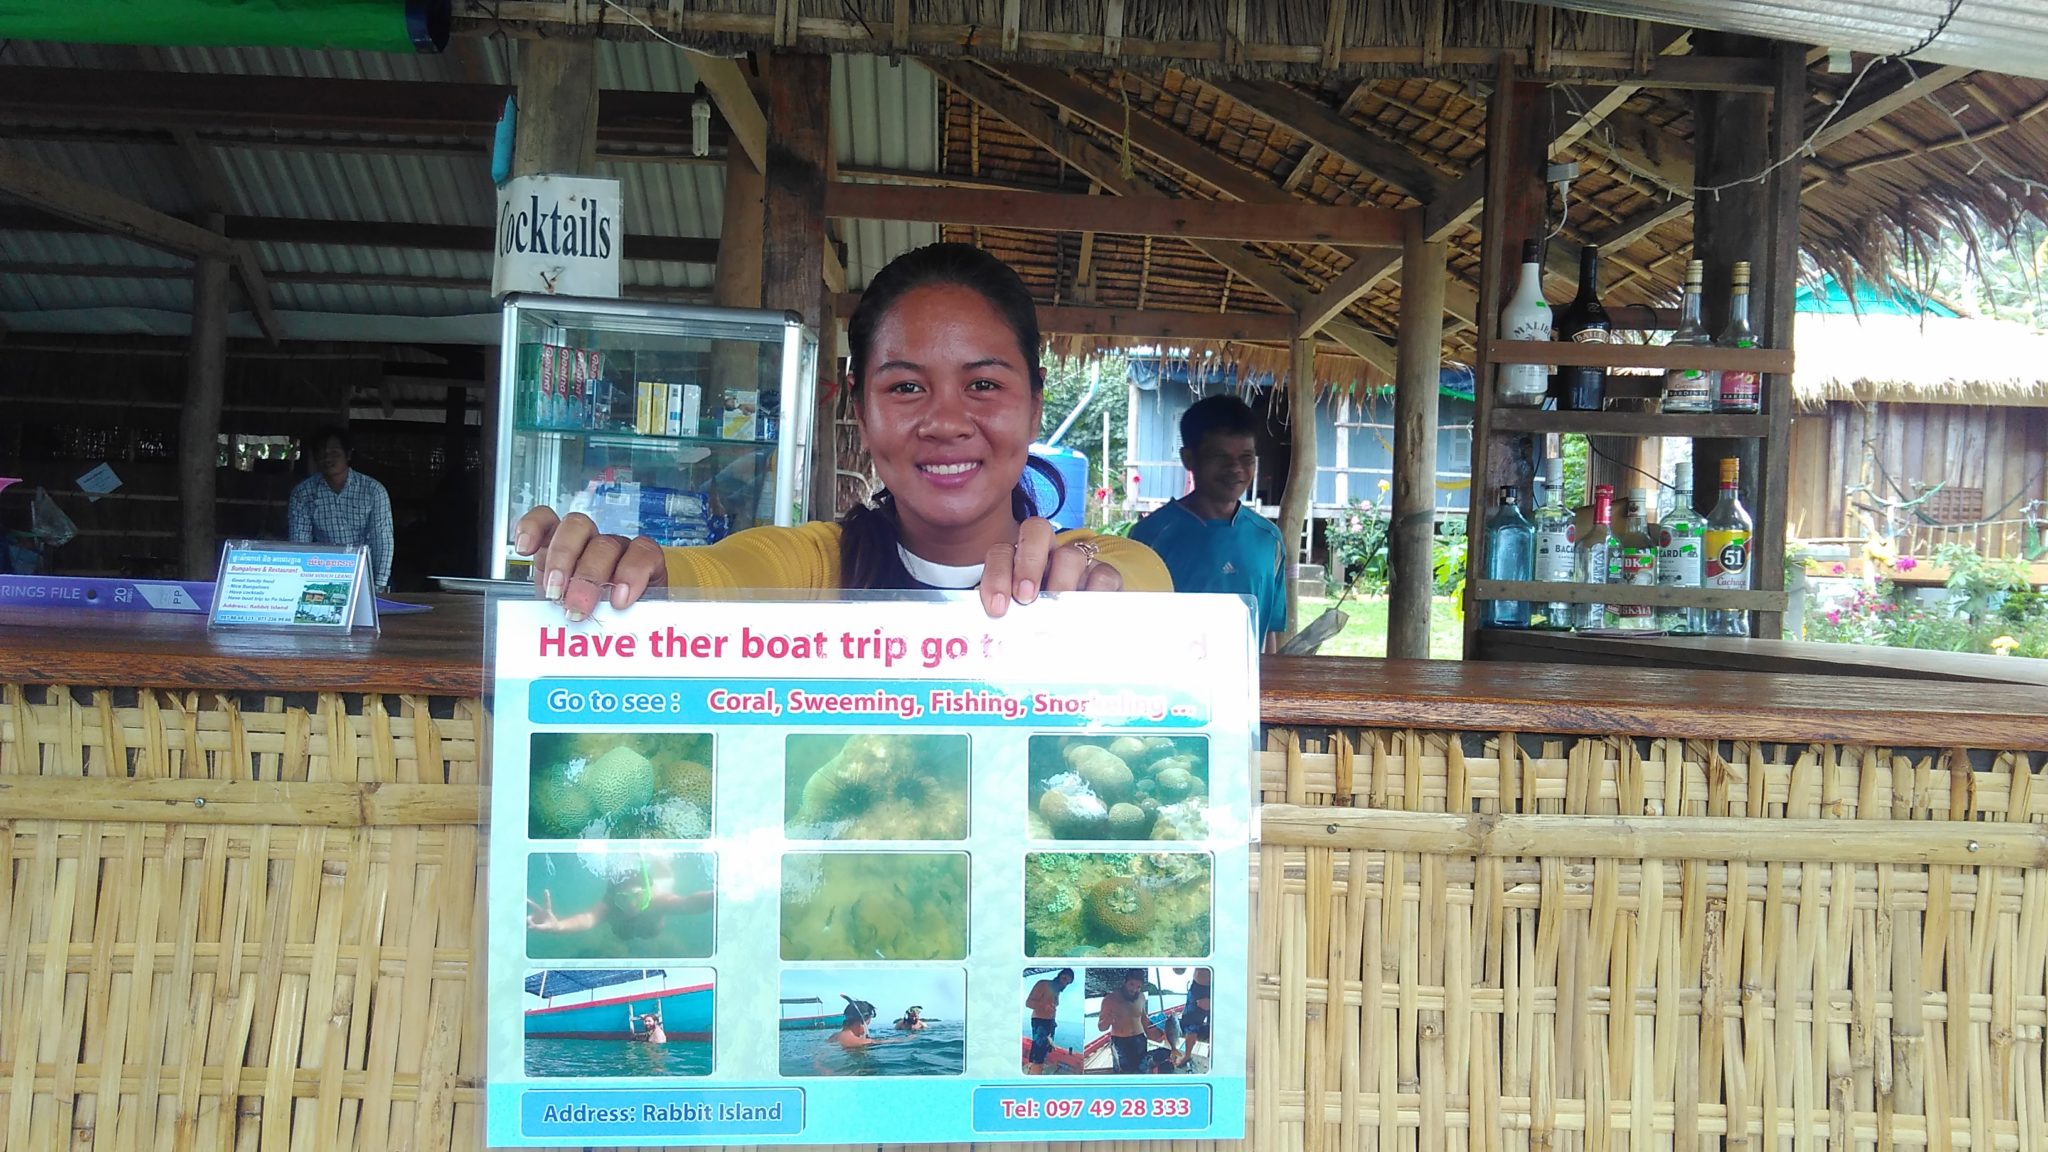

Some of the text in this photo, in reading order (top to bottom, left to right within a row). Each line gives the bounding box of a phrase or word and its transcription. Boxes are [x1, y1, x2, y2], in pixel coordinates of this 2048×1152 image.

[499, 195, 612, 259] Cocktails
[1724, 549, 1743, 566] 51
[50, 587, 81, 600] FILE
[114, 587, 128, 602] 20
[173, 590, 182, 605] PP
[539, 627, 636, 657] Have
[649, 627, 728, 658] ther
[742, 627, 828, 659] boat
[840, 628, 908, 667] trip
[921, 636, 968, 668] go
[549, 689, 583, 711] Go
[592, 691, 616, 711] to
[708, 690, 780, 716] Coral,
[788, 690, 923, 717] Sweeming,
[931, 691, 1026, 718] Fishing,
[543, 1102, 782, 1123] Address: Rabbit Island
[1002, 1099, 1190, 1118] Tel: 097 49 28 333
